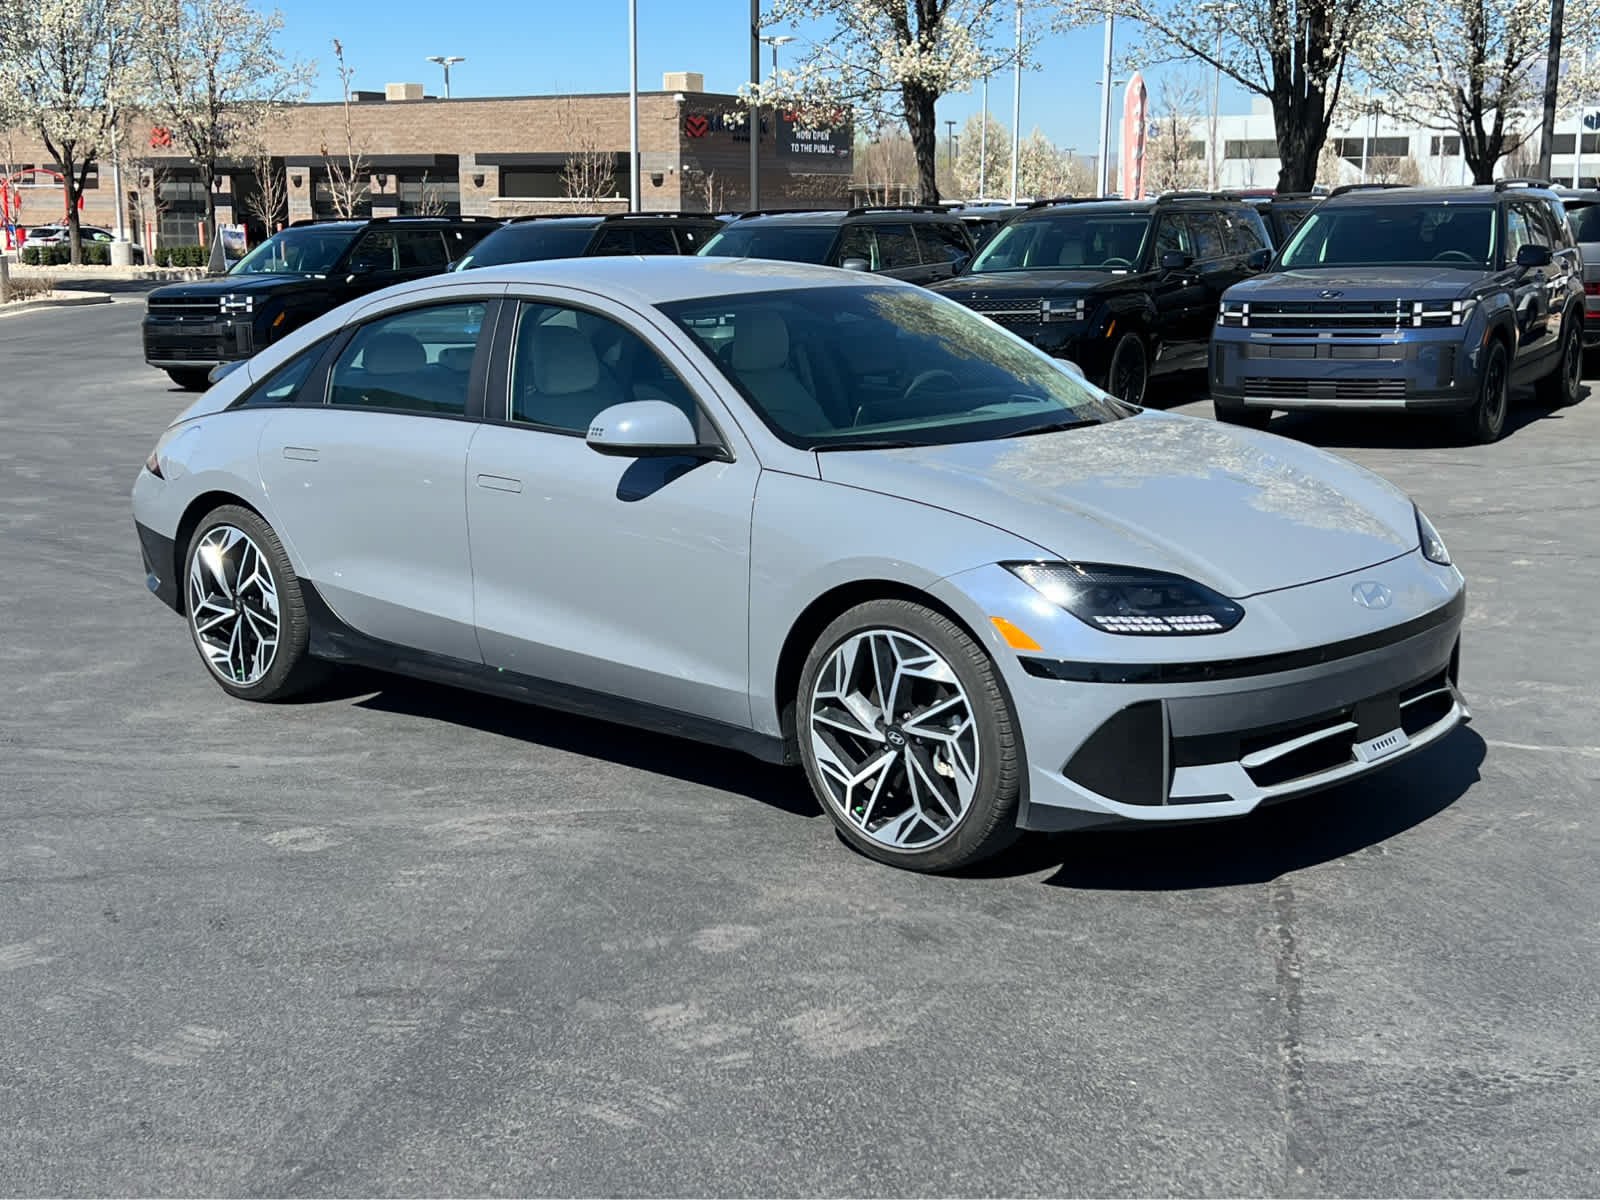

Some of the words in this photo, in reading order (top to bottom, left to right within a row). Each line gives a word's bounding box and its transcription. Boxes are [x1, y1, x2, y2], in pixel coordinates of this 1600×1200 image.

[812, 130, 830, 141] OPEN
[791, 143, 800, 153] TO
[801, 143, 813, 153] THE
[813, 143, 836, 154] PUBLIC
